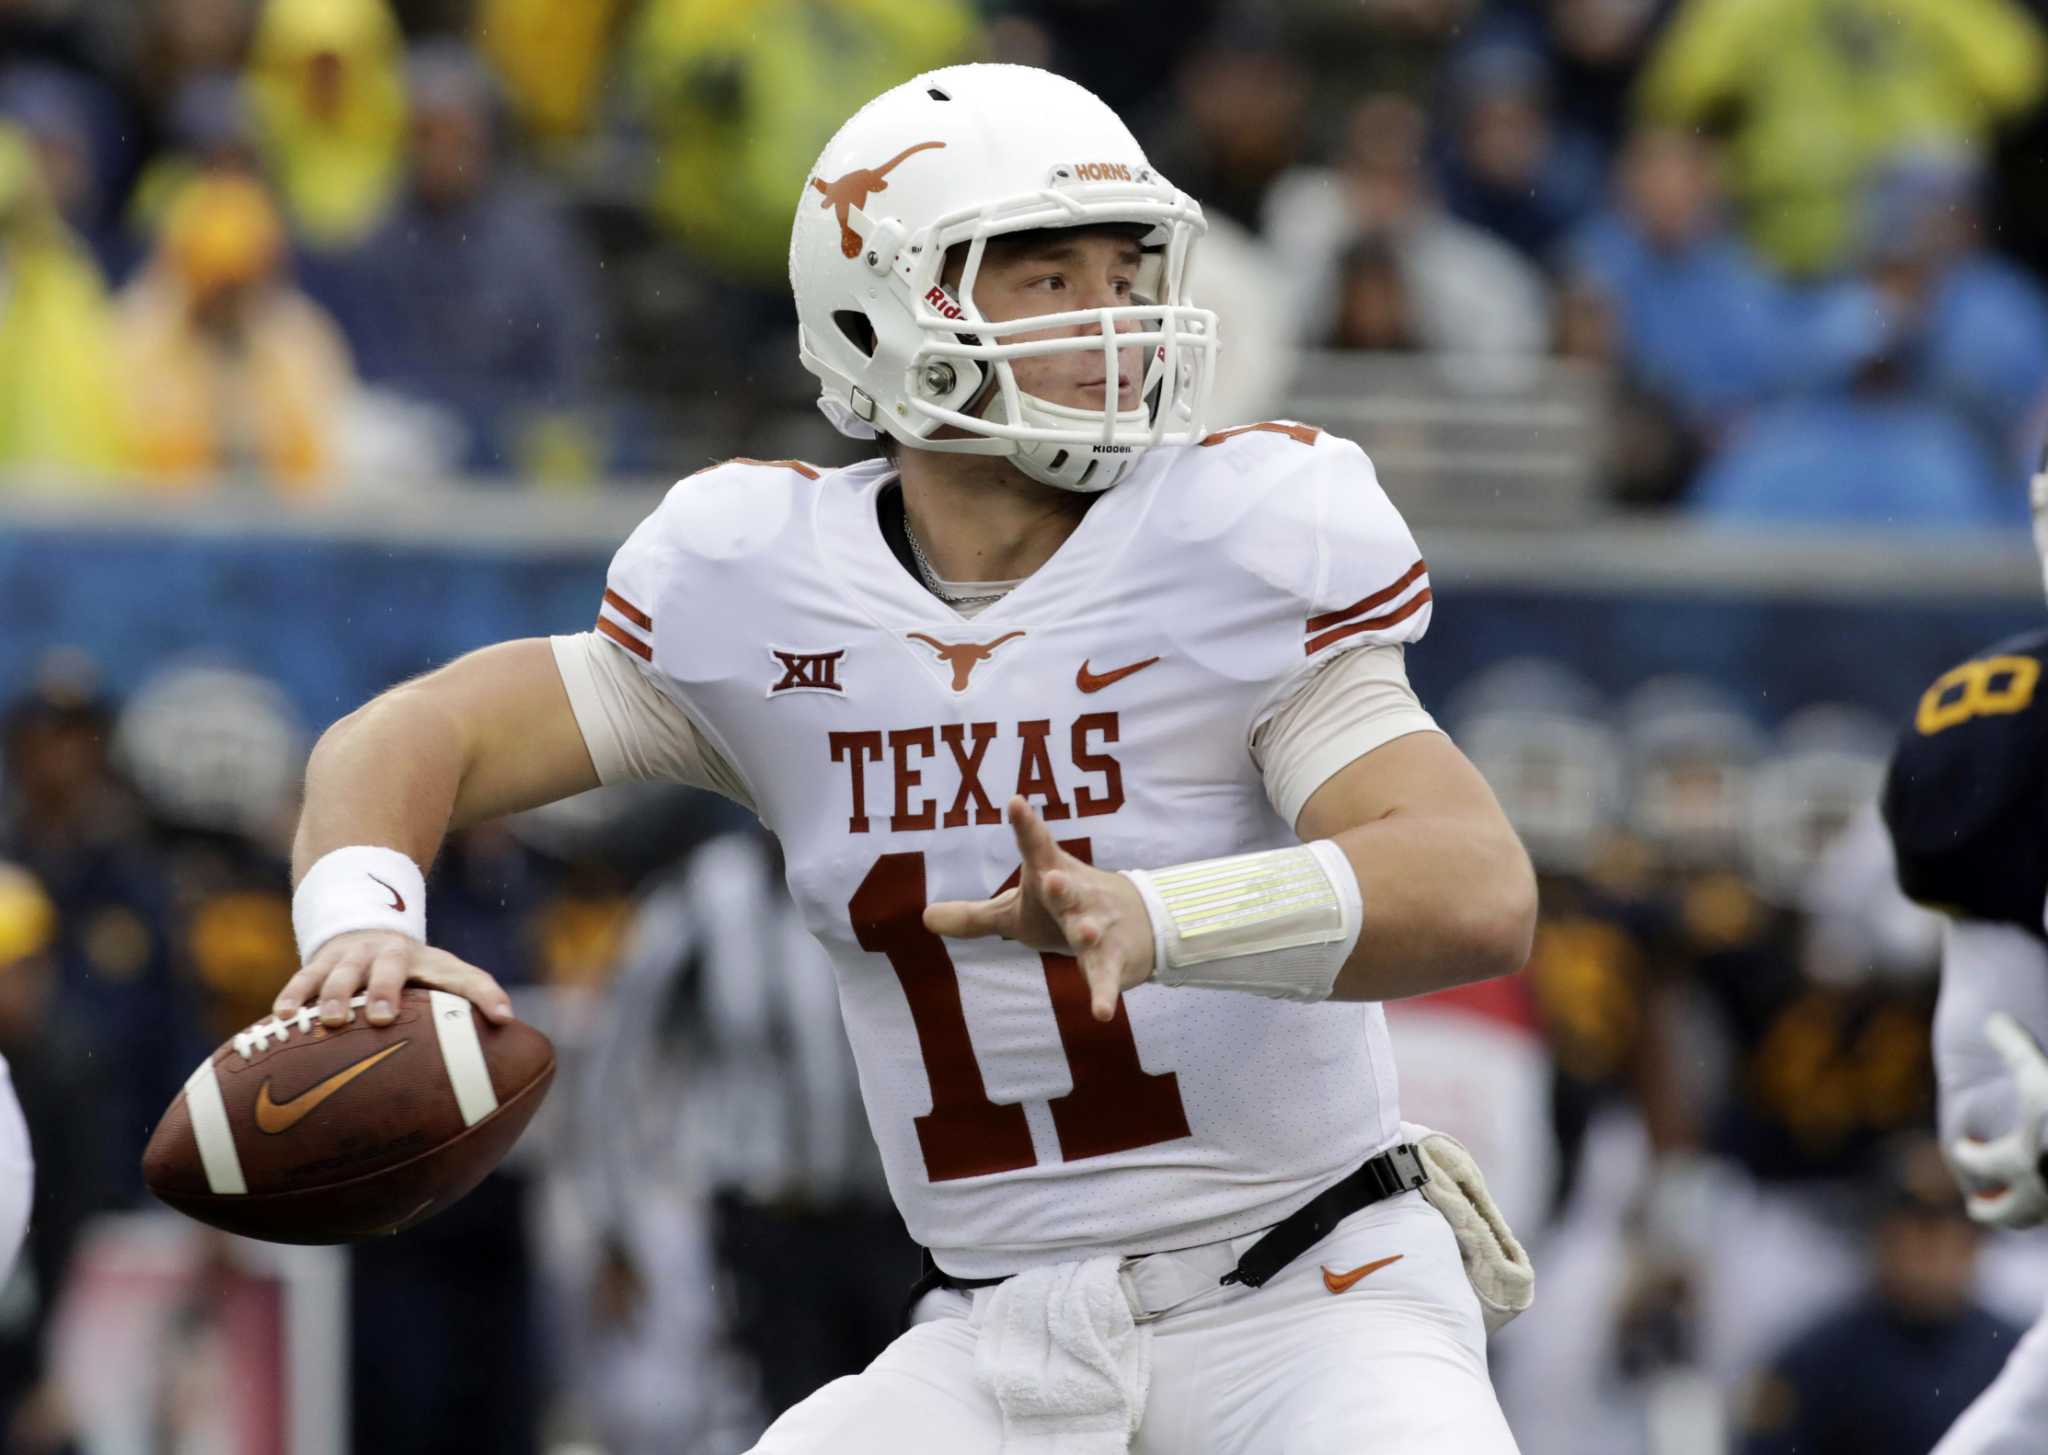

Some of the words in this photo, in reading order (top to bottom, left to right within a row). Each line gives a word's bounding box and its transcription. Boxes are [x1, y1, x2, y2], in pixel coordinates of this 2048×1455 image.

[1074, 163, 1132, 182] HORNS
[772, 649, 845, 692] XII
[1915, 655, 2040, 736] 8
[828, 711, 1126, 834] TEXAS
[848, 836, 1192, 1183] 11
